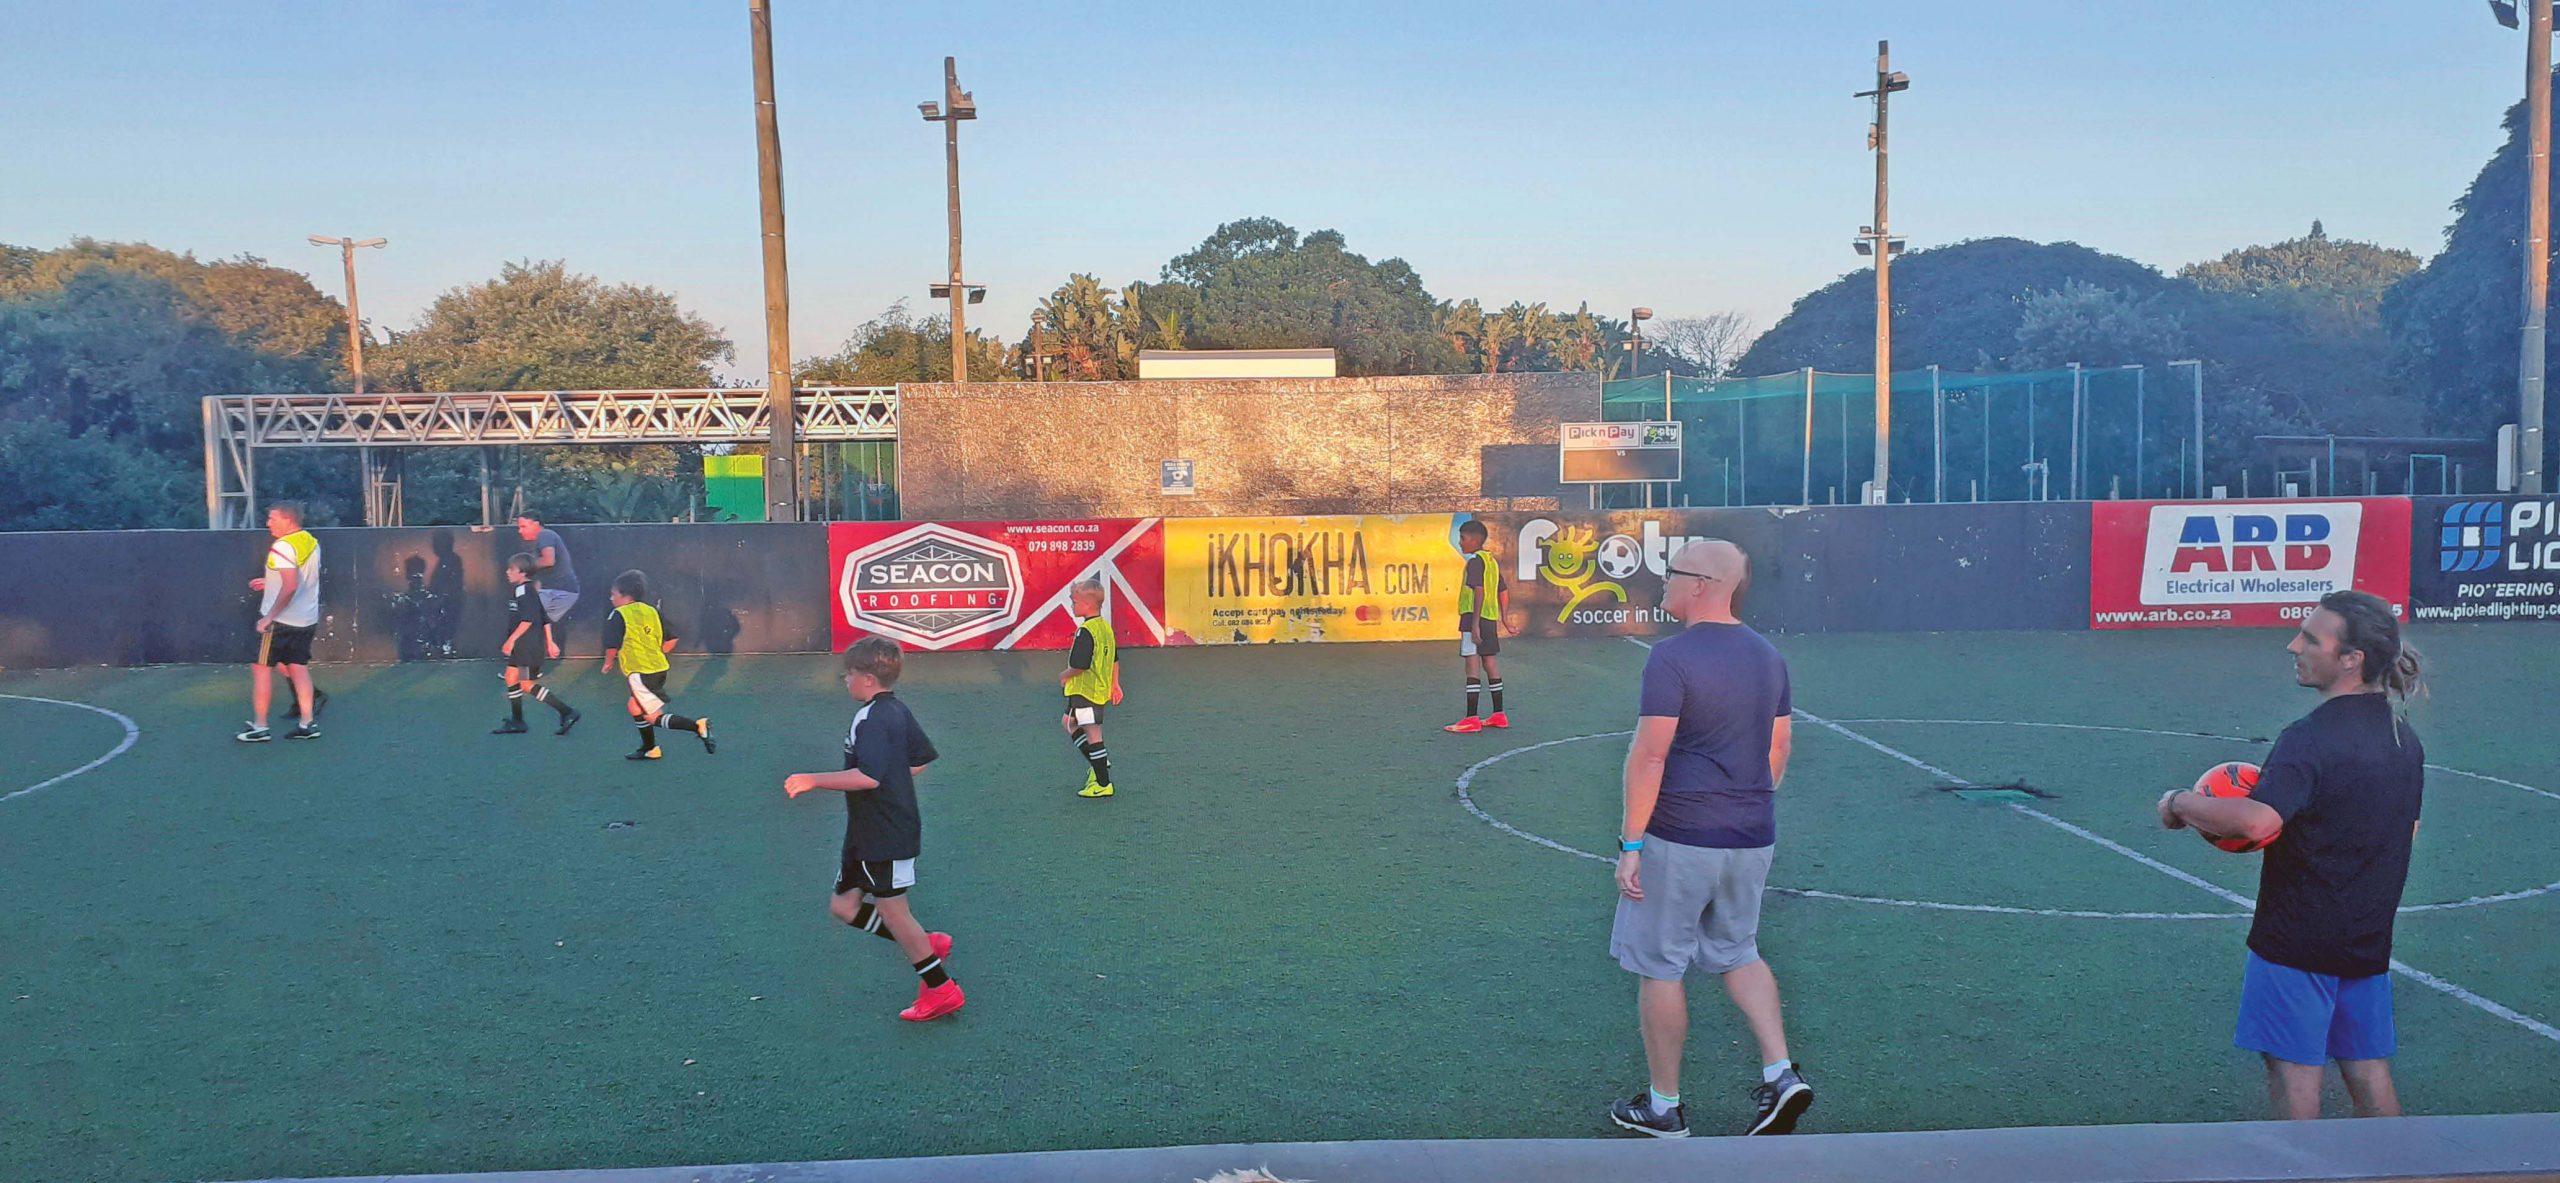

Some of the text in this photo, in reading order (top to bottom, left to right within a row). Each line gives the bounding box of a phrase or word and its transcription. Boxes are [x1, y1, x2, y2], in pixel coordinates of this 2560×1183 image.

[1569, 427, 1597, 439] Pick
[1608, 426, 1635, 439] Pay
[2510, 501, 2560, 537] PI
[1006, 524, 1100, 534] www.seacon.co.za
[1028, 540, 1096, 552] 079 898 2839
[1518, 518, 1704, 582] foot
[2169, 514, 2332, 573] ARB
[869, 561, 995, 585] SEACON
[2166, 577, 2333, 594] Electrical Wholesalers
[869, 594, 997, 607] ROOFING
[1391, 606, 1430, 621] VISA
[1573, 608, 1631, 624] soccer
[1635, 606, 1649, 622] in
[2095, 608, 2232, 622] www.arb.co.za
